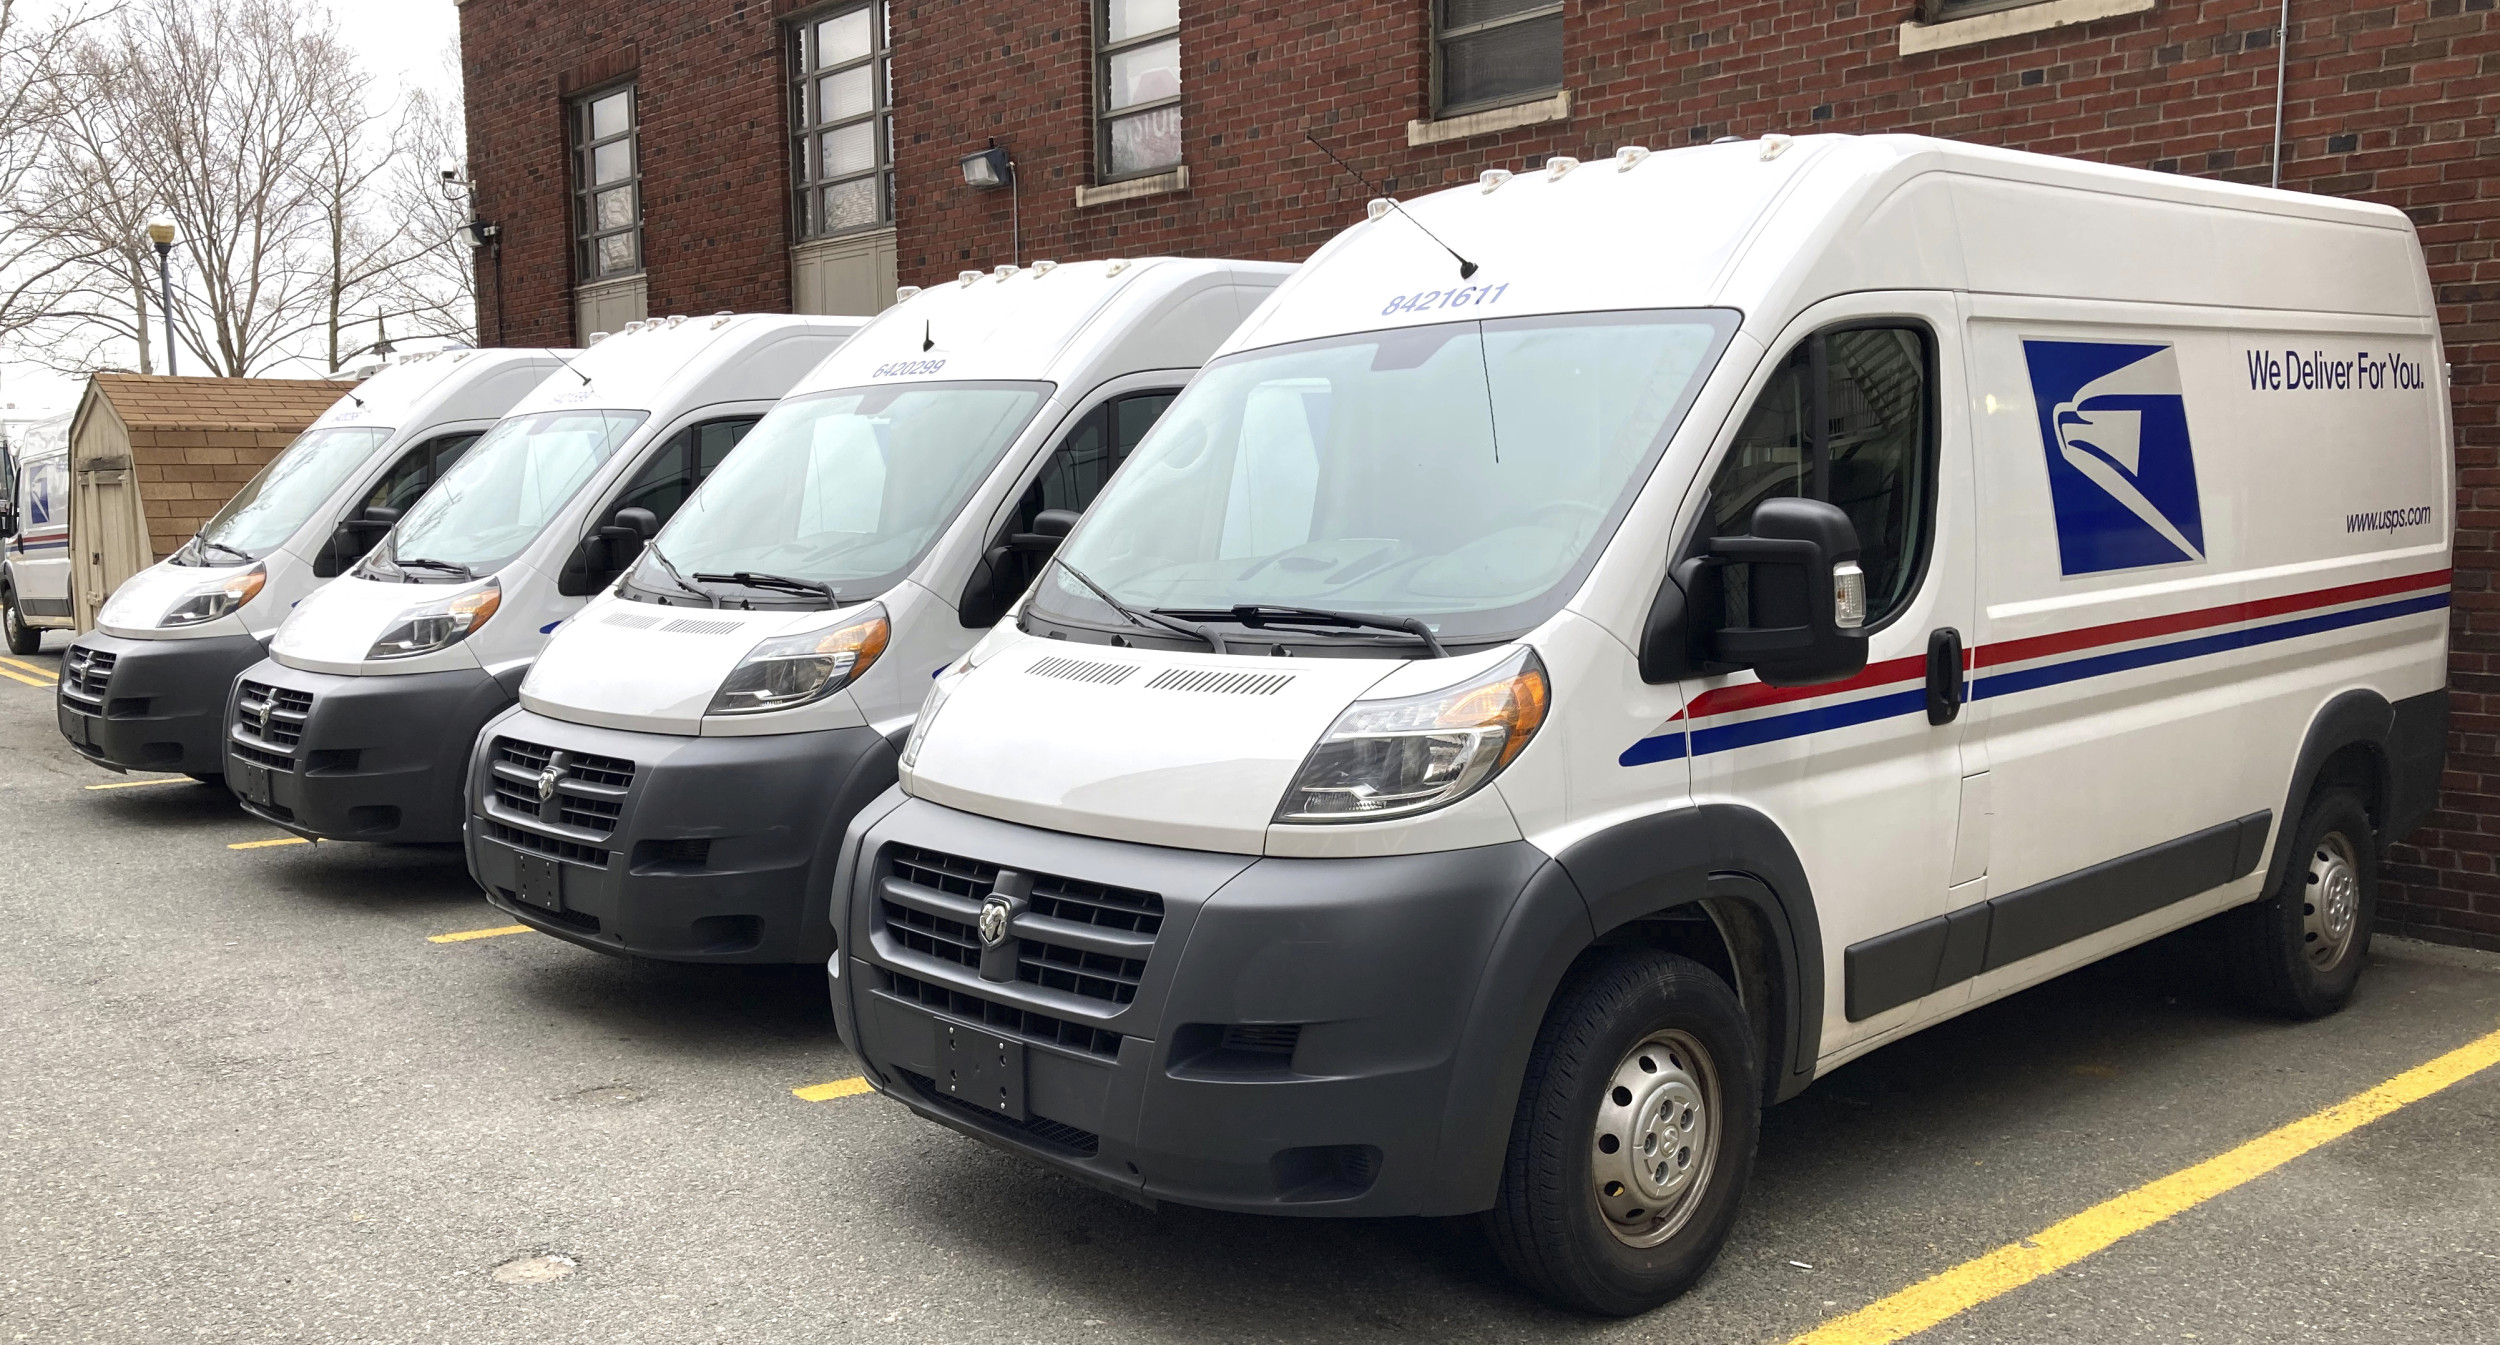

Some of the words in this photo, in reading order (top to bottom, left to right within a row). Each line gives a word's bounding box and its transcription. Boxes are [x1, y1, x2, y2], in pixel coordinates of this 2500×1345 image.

[1381, 282, 1510, 316] 8421611
[872, 359, 947, 378] 6420299
[2246, 350, 2281, 391] We
[2285, 350, 2354, 390] Deliver
[2358, 352, 2387, 390] For
[2388, 352, 2424, 390] You.
[2346, 506, 2431, 535] www.usps.com
